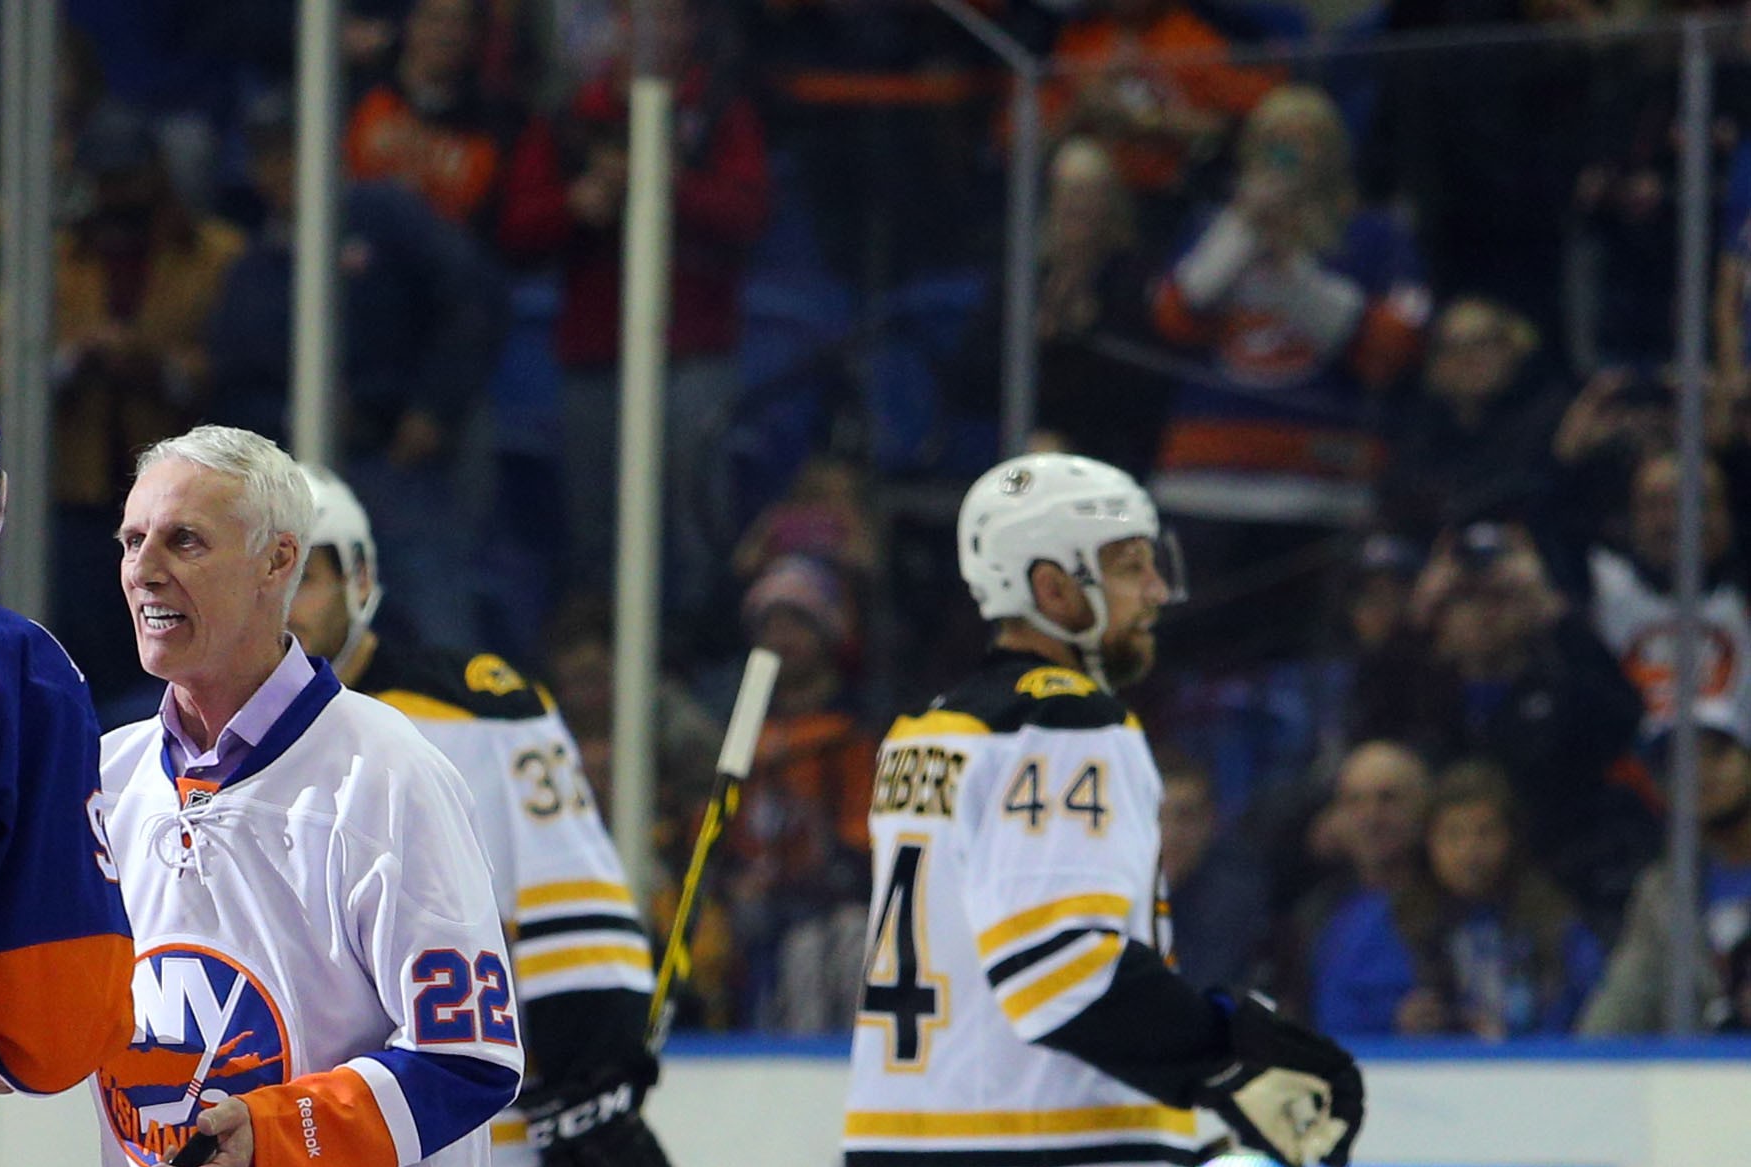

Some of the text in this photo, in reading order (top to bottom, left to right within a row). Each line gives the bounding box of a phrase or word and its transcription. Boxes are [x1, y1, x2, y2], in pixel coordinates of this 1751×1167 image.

[1003, 756, 1108, 838] 44
[412, 948, 517, 1048] 22
[296, 1096, 322, 1159] Reebok
[526, 1083, 632, 1149] CCM
